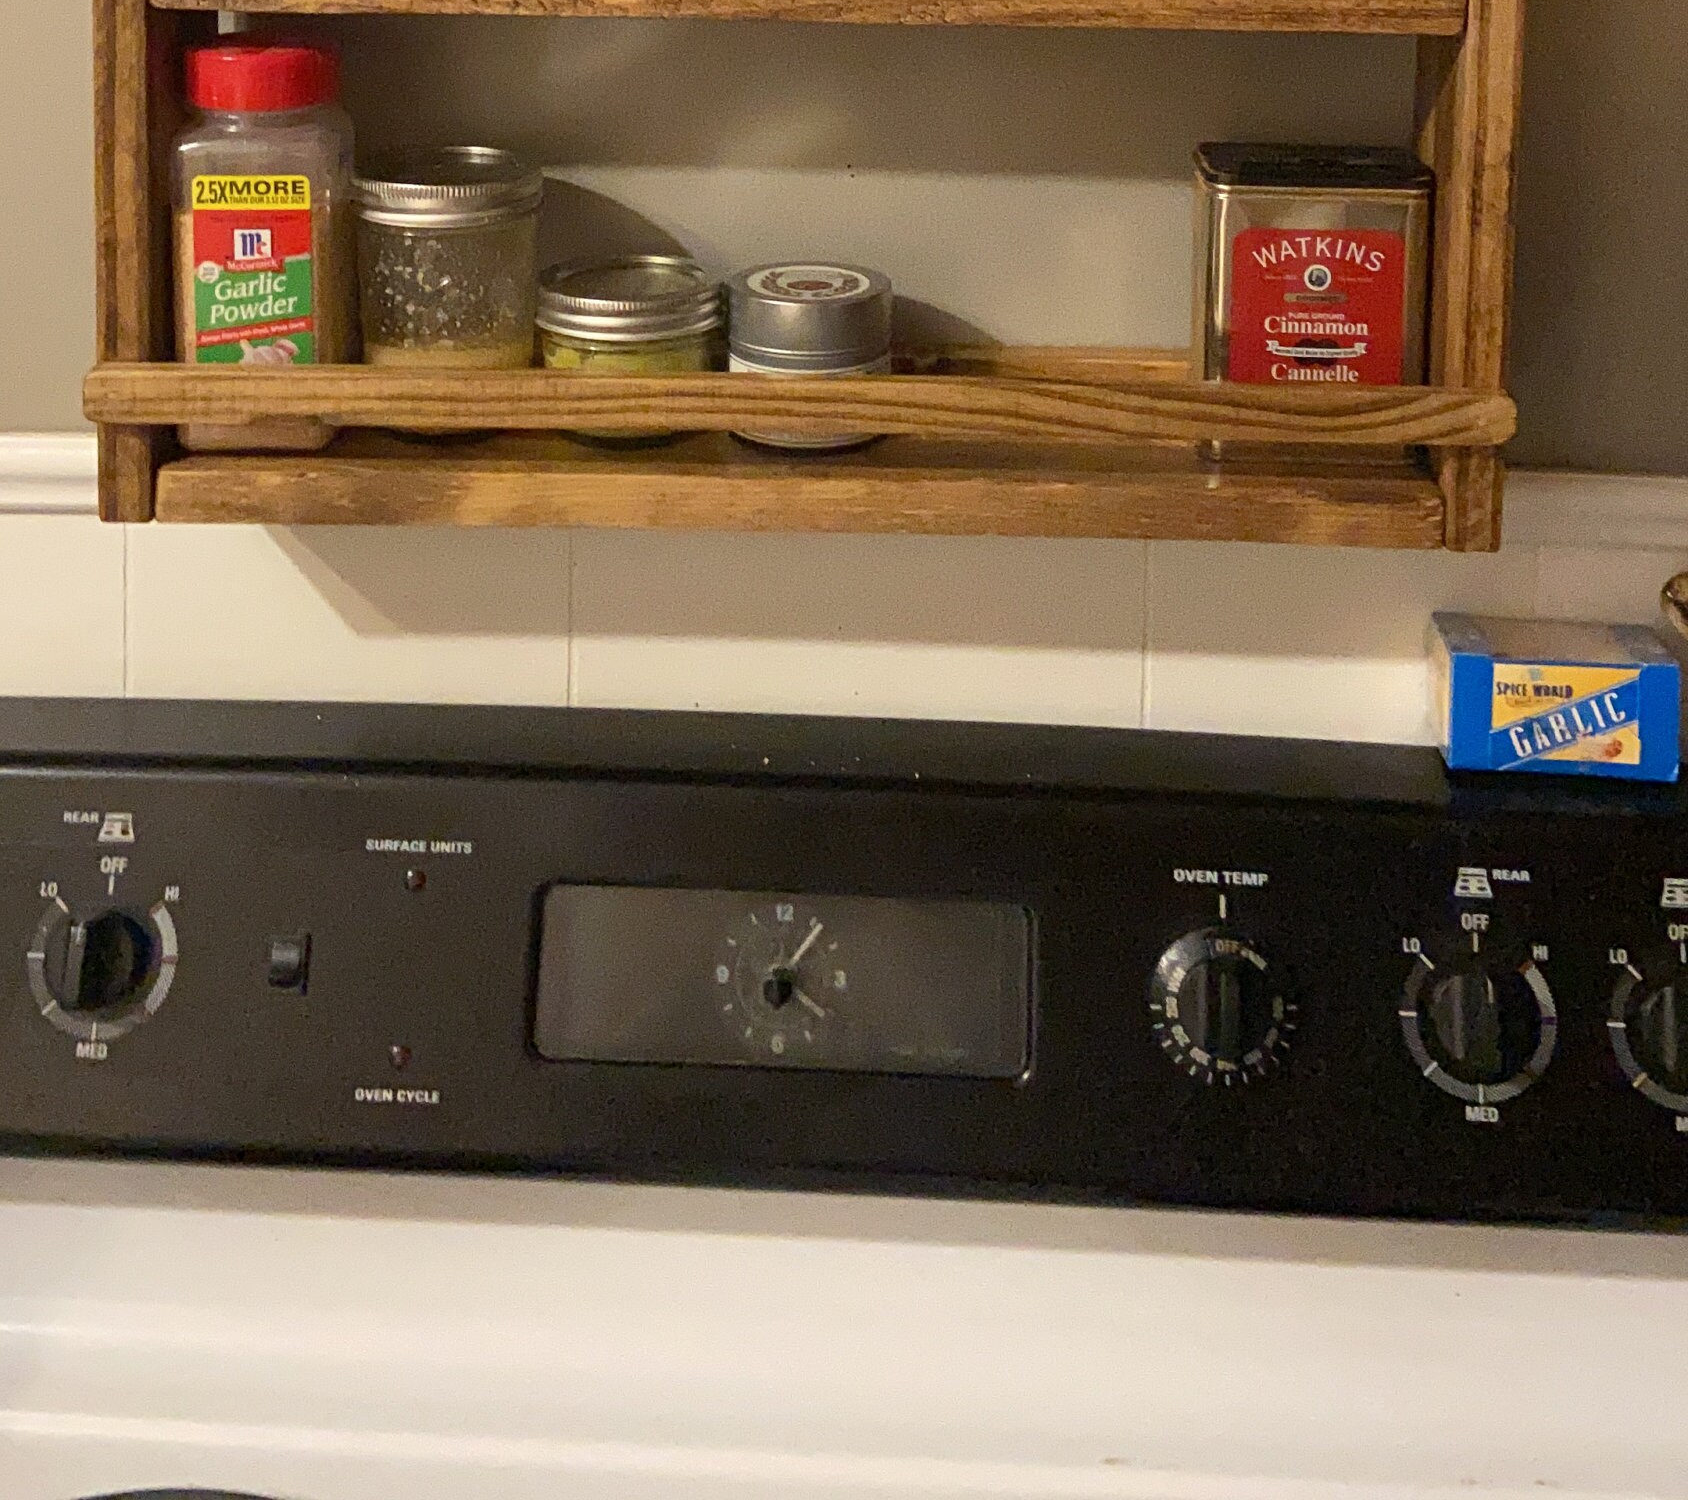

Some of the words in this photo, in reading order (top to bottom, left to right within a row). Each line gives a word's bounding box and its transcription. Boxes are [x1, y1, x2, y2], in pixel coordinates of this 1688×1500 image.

[229, 180, 305, 196] MORE
[1252, 236, 1385, 272] WATKINS
[214, 271, 288, 301] Garlic
[210, 294, 298, 325] Powder
[1264, 315, 1368, 336] Cinnamon
[1270, 363, 1359, 382] Cannelle
[1496, 681, 1527, 697] SPICE
[1532, 684, 1574, 699] WORLD
[1509, 692, 1626, 758] GARLIC
[63, 810, 99, 824] REAR
[365, 839, 427, 853] SURFACE
[430, 840, 472, 854] UNITS
[100, 855, 128, 873] OFF
[1173, 868, 1218, 884] OVEN
[1222, 871, 1269, 887] TEMP
[1492, 868, 1530, 882] REAR
[40, 881, 58, 897] LO
[164, 885, 180, 901] HI
[1461, 913, 1489, 931] OFF
[1668, 924, 1688, 941] OF
[1402, 937, 1421, 953] LO
[1532, 945, 1549, 961] HI
[1609, 948, 1628, 964] LO
[75, 1042, 108, 1059] MED
[355, 1087, 393, 1102] OVEN
[396, 1088, 440, 1104] CYCLE
[1465, 1105, 1499, 1123] MED
